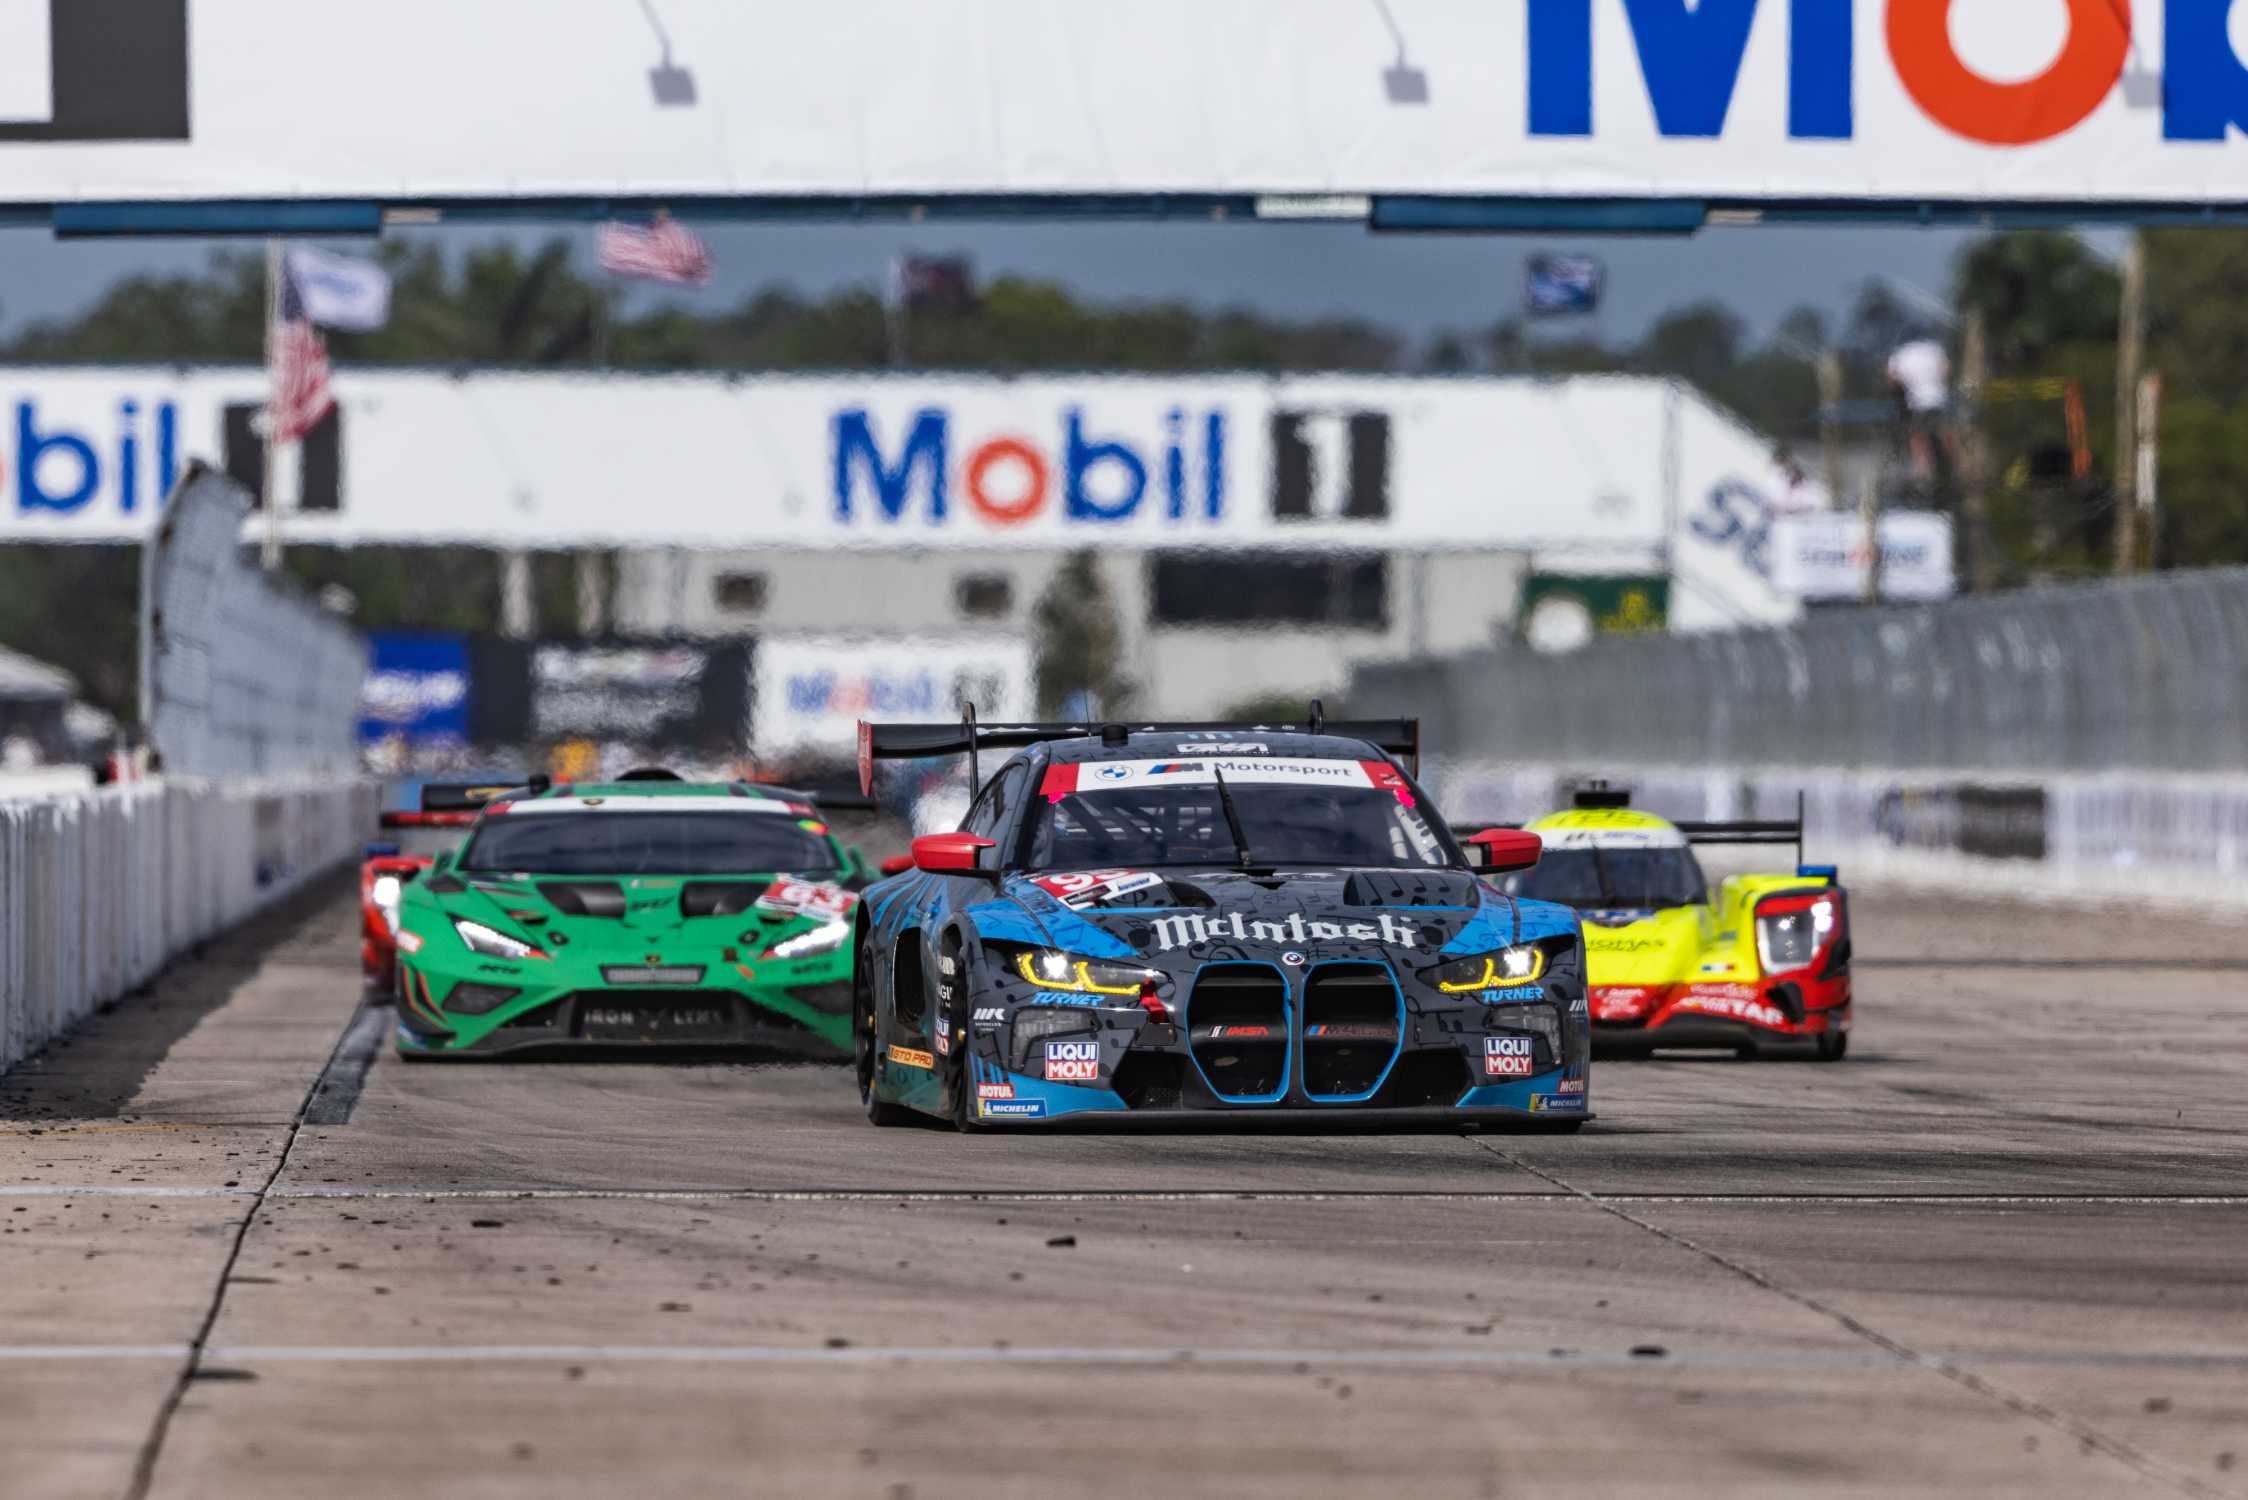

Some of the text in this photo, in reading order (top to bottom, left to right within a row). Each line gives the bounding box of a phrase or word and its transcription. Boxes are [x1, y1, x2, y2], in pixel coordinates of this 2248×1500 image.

[4, 400, 178, 512] bil
[830, 408, 1227, 524] Mobil
[1214, 761, 1353, 777] Motorsport
[1150, 911, 1417, 950] McIntosh
[1032, 991, 1105, 1007] TURNER
[1482, 986, 1544, 1003] TURNER
[1048, 1044, 1096, 1061] LIQUI
[1486, 1039, 1530, 1056] LIQUI
[893, 1050, 932, 1066] GTD PRO
[1488, 1057, 1530, 1072] MOLY
[1048, 1062, 1097, 1078] MOLY
[978, 1084, 1013, 1098] MOTUL
[991, 1104, 1040, 1113] MICHELIN
